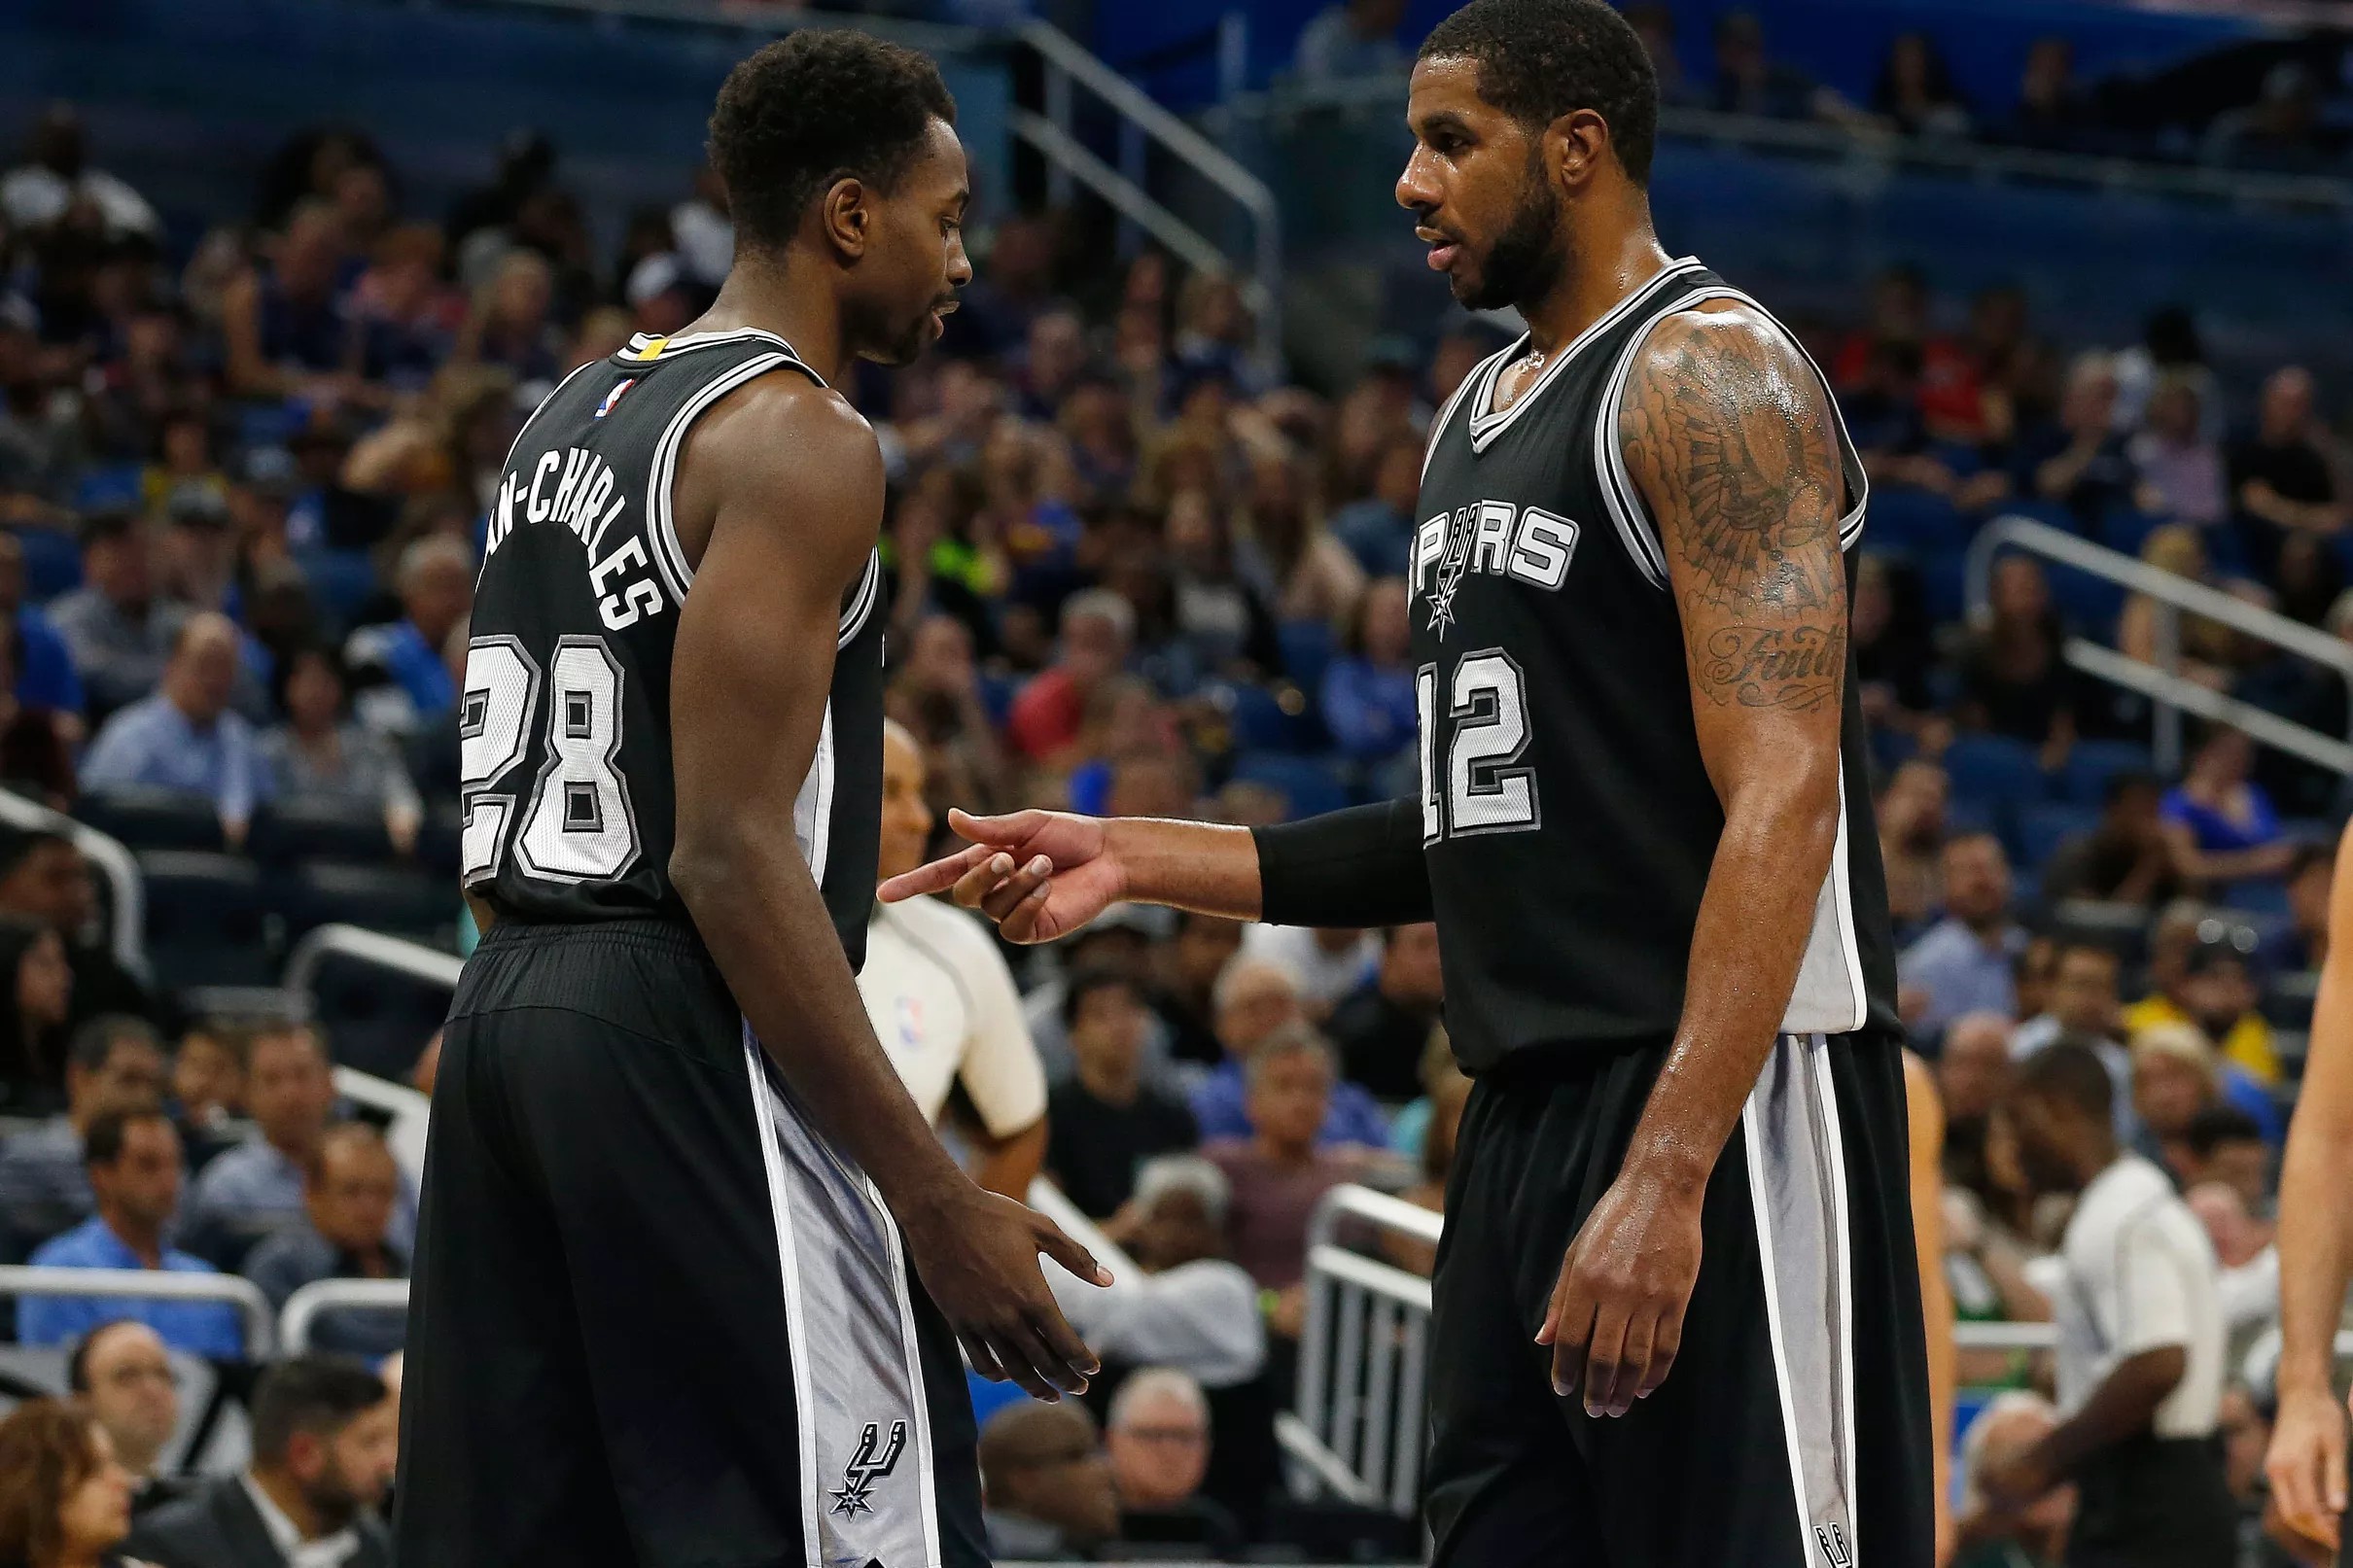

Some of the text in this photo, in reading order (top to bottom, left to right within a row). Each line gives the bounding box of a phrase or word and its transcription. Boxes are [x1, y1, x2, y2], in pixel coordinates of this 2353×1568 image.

[1407, 500, 1581, 642] PURS
[461, 634, 642, 888] 28
[1417, 646, 1541, 850] 12
